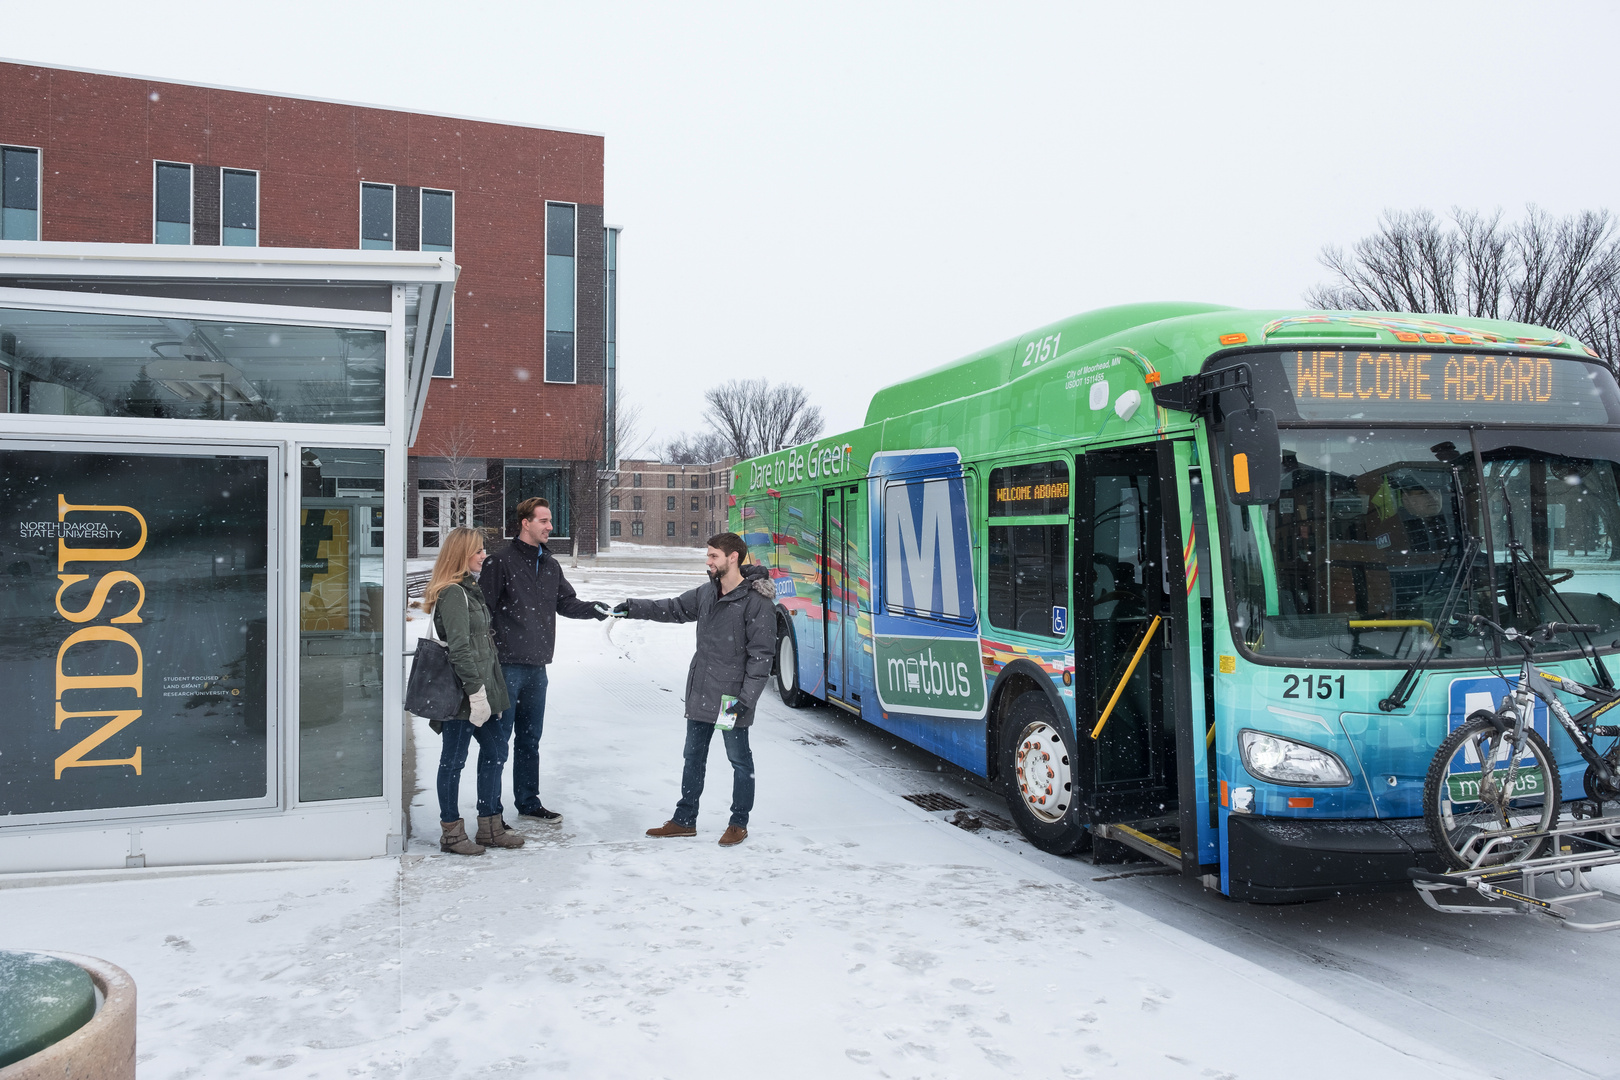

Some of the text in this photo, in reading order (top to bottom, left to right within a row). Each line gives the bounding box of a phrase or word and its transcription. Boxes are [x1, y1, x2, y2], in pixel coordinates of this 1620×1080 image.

[1022, 332, 1061, 367] 2151
[1066, 356, 1121, 379] City of Moorhead, MN
[1297, 350, 1552, 401] WELCOME ABOARD
[1065, 378, 1083, 389] USDOT
[750, 443, 852, 490] Dare to Be Green
[996, 483, 1069, 501] WELCOME ABOARD
[20, 521, 108, 531] NORTH DAKOTA
[20, 529, 123, 538] STATE UNIVERSITY
[885, 477, 960, 619] M
[54, 494, 148, 780] NDSU
[1282, 674, 1344, 700] 2151
[1460, 774, 1537, 796] mus
